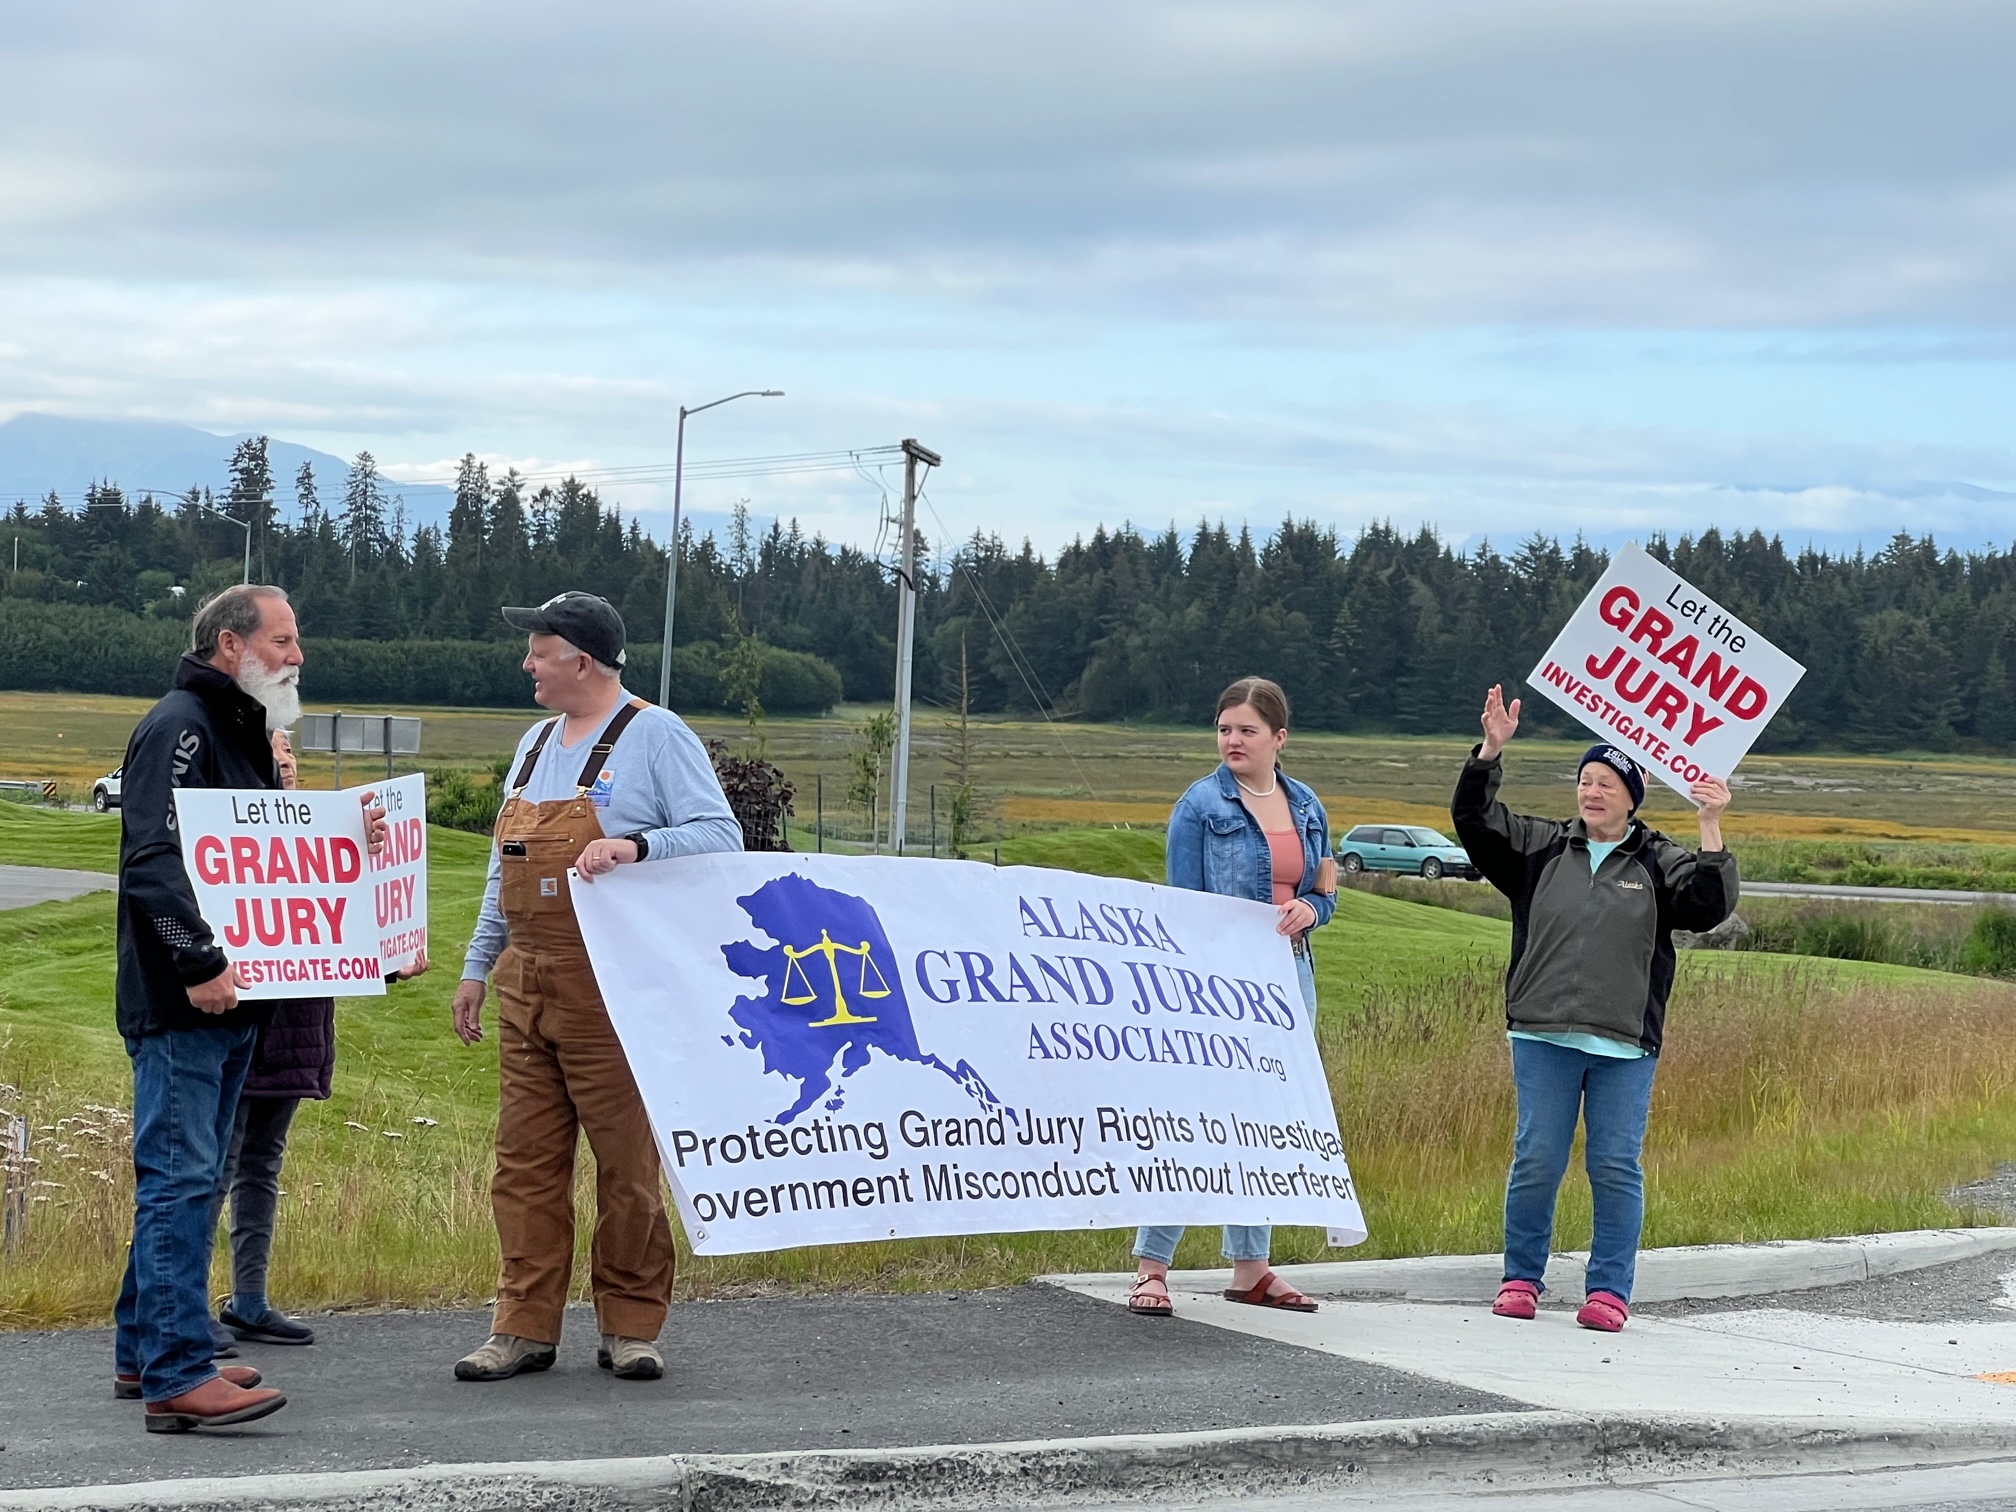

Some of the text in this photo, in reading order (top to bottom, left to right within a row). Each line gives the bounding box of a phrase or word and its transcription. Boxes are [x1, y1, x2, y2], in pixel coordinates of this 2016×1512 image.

[1666, 583, 1747, 654] Let the
[1599, 585, 1768, 721] GRAND
[1585, 646, 1725, 747] JURY
[232, 796, 312, 824] Let the
[386, 786, 403, 812] the
[194, 834, 361, 886] GRAND
[368, 817, 423, 873] AND
[223, 896, 347, 948] JURY
[374, 873, 416, 928] URY
[1019, 895, 1186, 955] ALASKA
[233, 957, 380, 983] ESTIGATE.COM
[914, 949, 1296, 1031] GRAND JURORS
[1027, 1022, 1287, 1081] ASSOCIATION.org
[671, 1107, 1347, 1168] Protecting Grand Jury Rights to Investiga
[693, 1158, 1354, 1222] overnment Misconduct without Interferen
